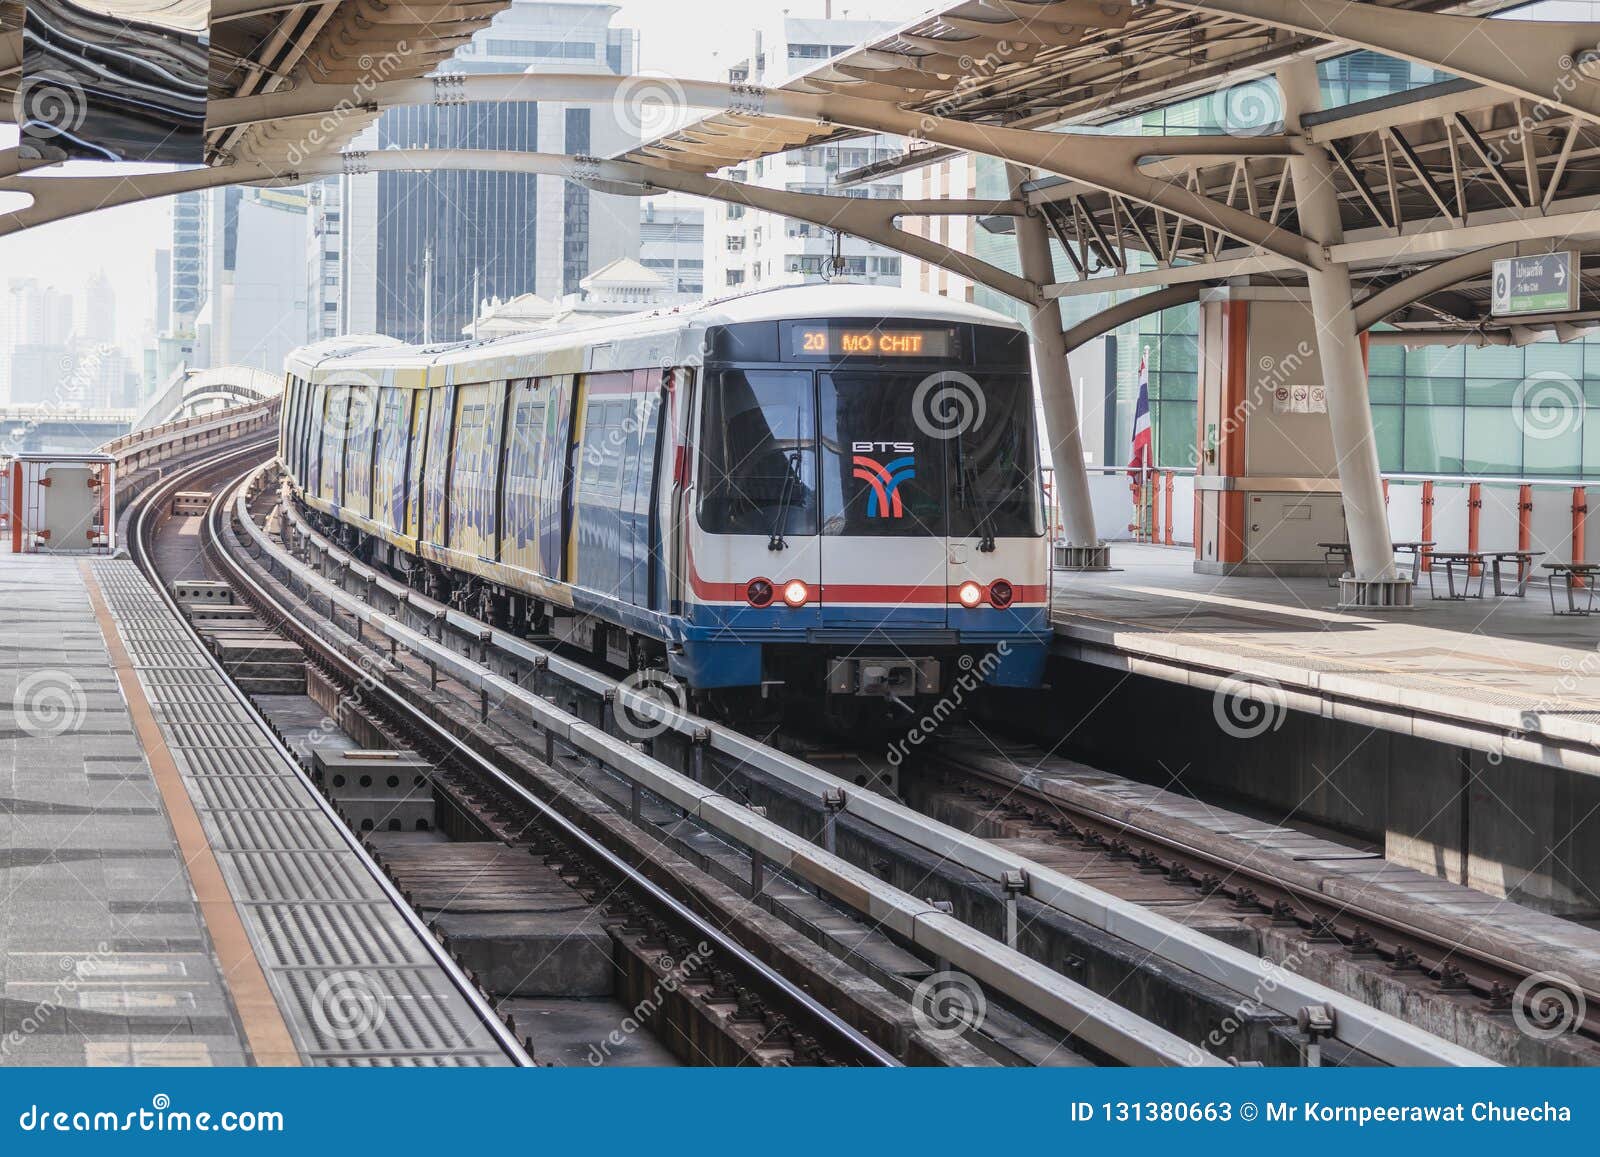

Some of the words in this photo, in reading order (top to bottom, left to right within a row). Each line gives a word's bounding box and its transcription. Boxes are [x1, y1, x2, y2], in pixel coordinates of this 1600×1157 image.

[803, 333, 825, 350] 20
[842, 335, 872, 350] MO
[879, 335, 922, 350] CHIT
[852, 441, 915, 453] BTS
